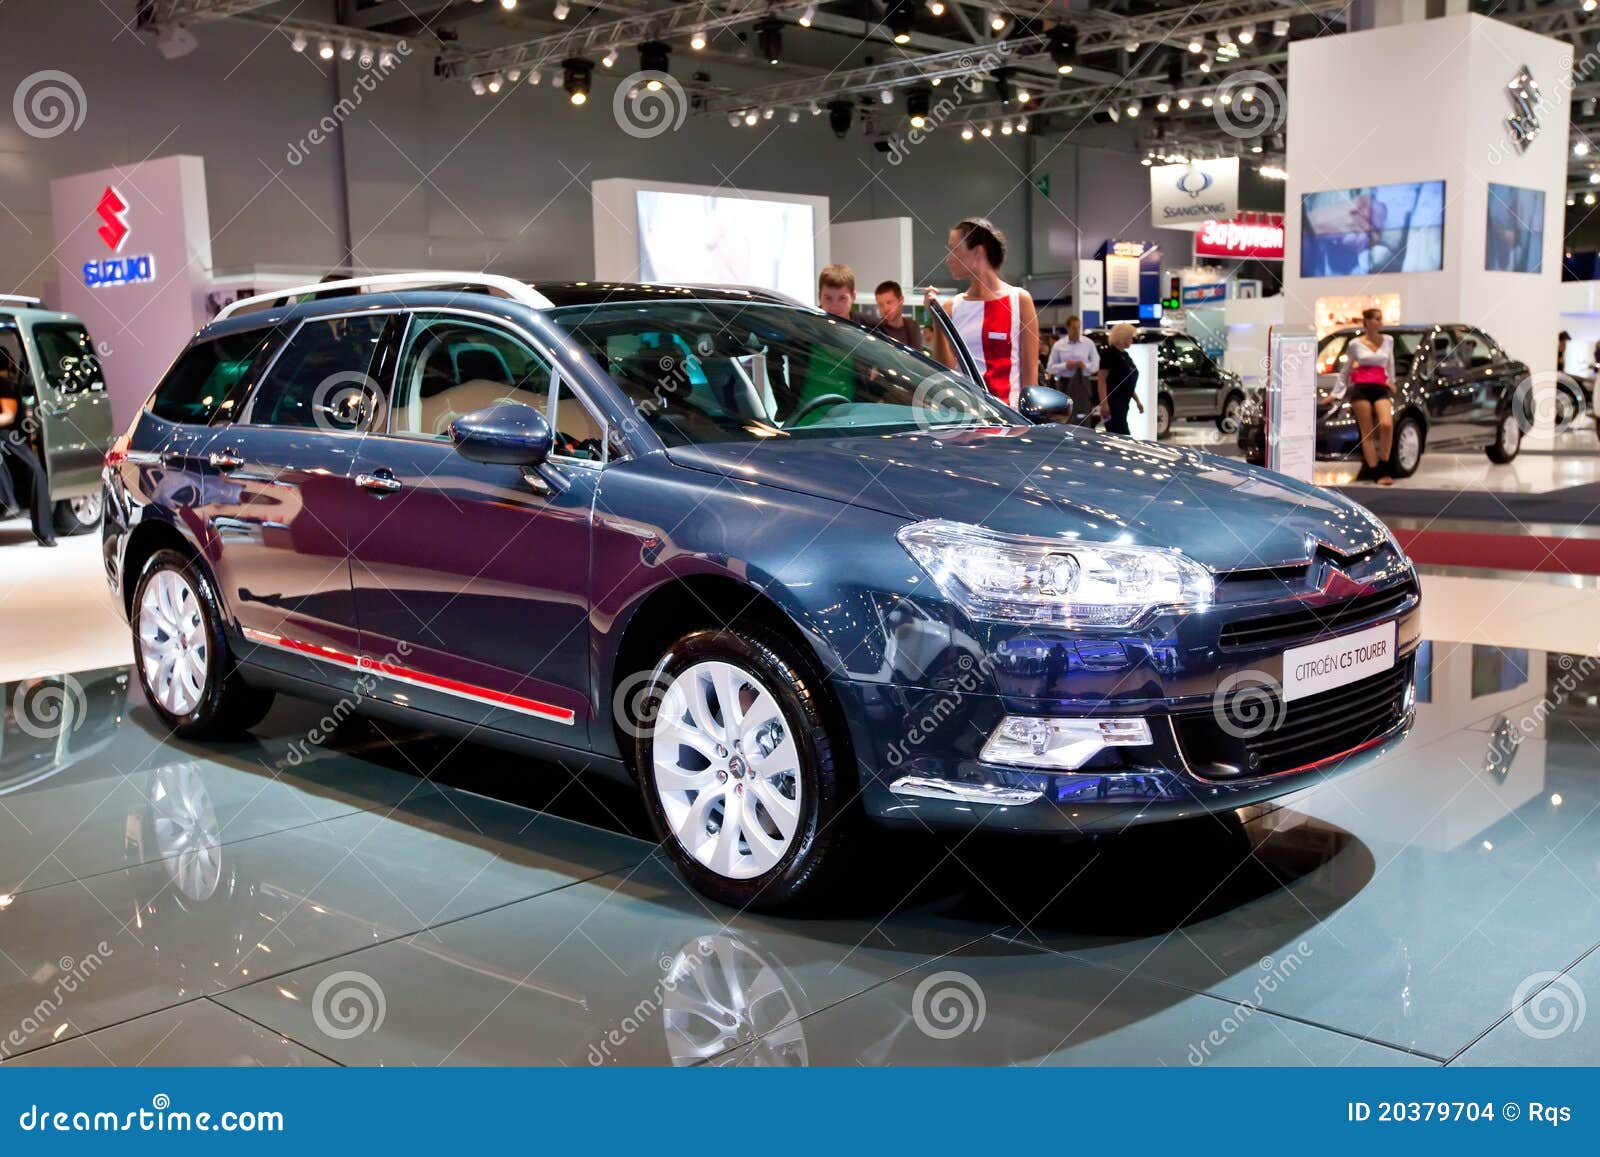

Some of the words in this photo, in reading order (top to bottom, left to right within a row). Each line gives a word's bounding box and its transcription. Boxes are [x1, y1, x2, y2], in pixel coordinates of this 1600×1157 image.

[83, 256, 154, 288] SUZUKI
[1295, 654, 1338, 681] CITROËN
[1340, 651, 1353, 669] C5
[1355, 640, 1387, 664] TOURER
